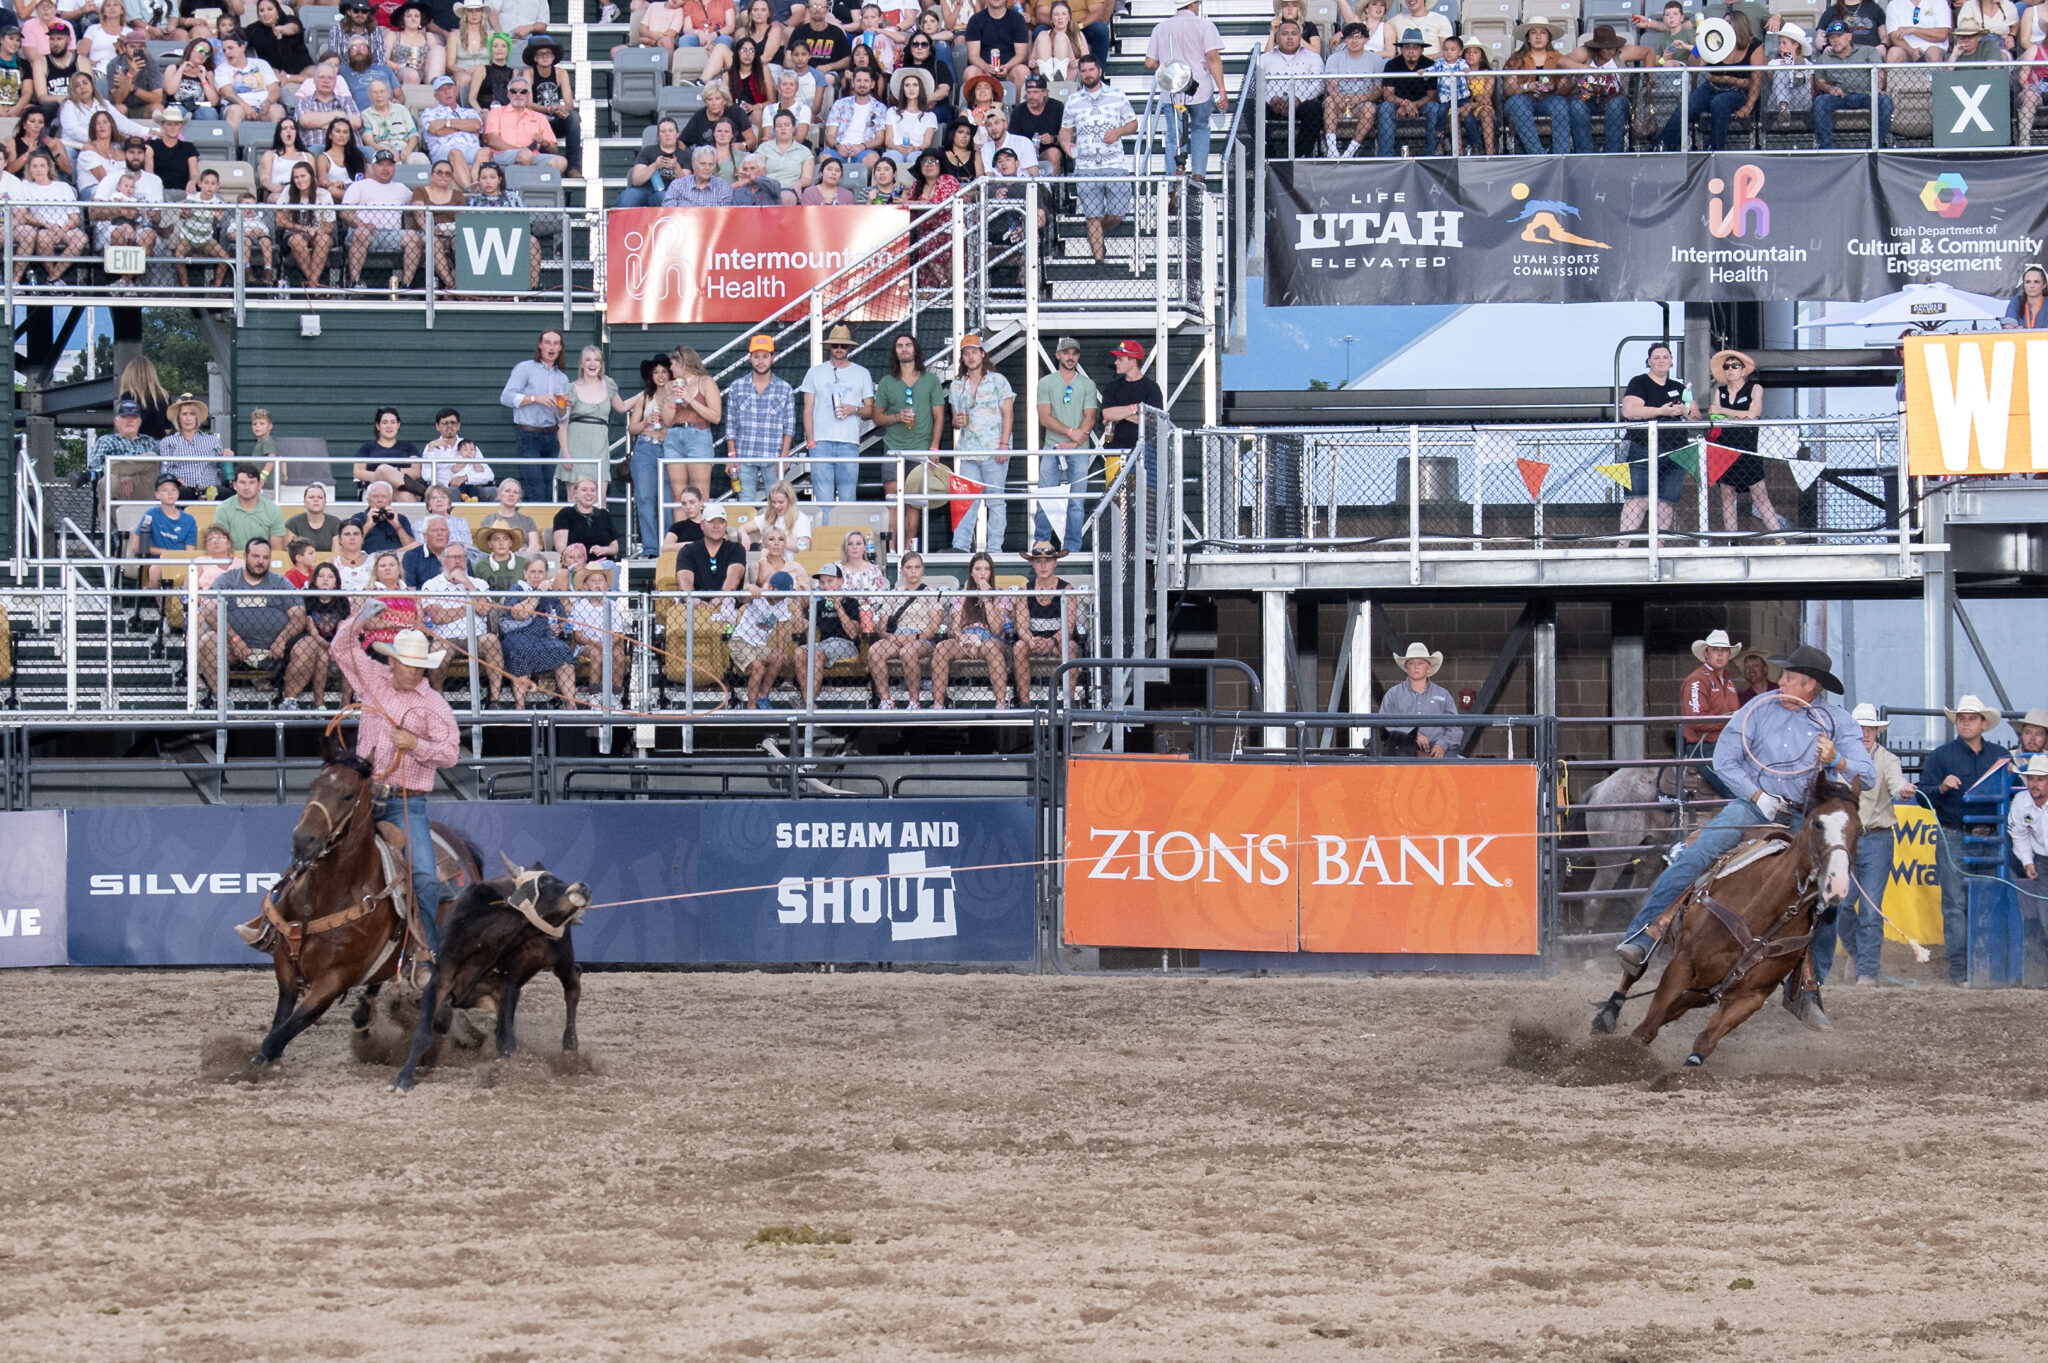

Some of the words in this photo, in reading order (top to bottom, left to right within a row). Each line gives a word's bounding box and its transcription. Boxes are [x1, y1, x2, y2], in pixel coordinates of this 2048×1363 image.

[1950, 84, 1995, 133] X
[1352, 192, 1406, 204] LIFE
[1295, 210, 1464, 250] UTAH
[1890, 226, 1915, 236] Utah
[1918, 226, 1983, 237] Department
[1985, 224, 1998, 235] of
[462, 227, 523, 275] W
[1671, 245, 1806, 263] Intermountain
[1847, 238, 1915, 255] Cultural
[1920, 238, 1934, 254] &
[1938, 236, 2043, 255] Community
[113, 250, 140, 270] EXIT
[1312, 257, 1447, 268] ELEVATED
[1513, 255, 1547, 265] UTAH
[1552, 254, 1599, 264] SPORTS
[1887, 255, 2002, 276] Engagement
[1513, 266, 1598, 276] COMMISSION
[1709, 266, 1768, 283] Health
[707, 275, 786, 299] Health
[776, 822, 892, 848] SCREAM
[899, 822, 959, 847] AND
[1088, 826, 1289, 885] ZIONS
[1311, 834, 1504, 887] BANK
[90, 873, 283, 895] SILVER
[777, 876, 954, 924] SHOUT
